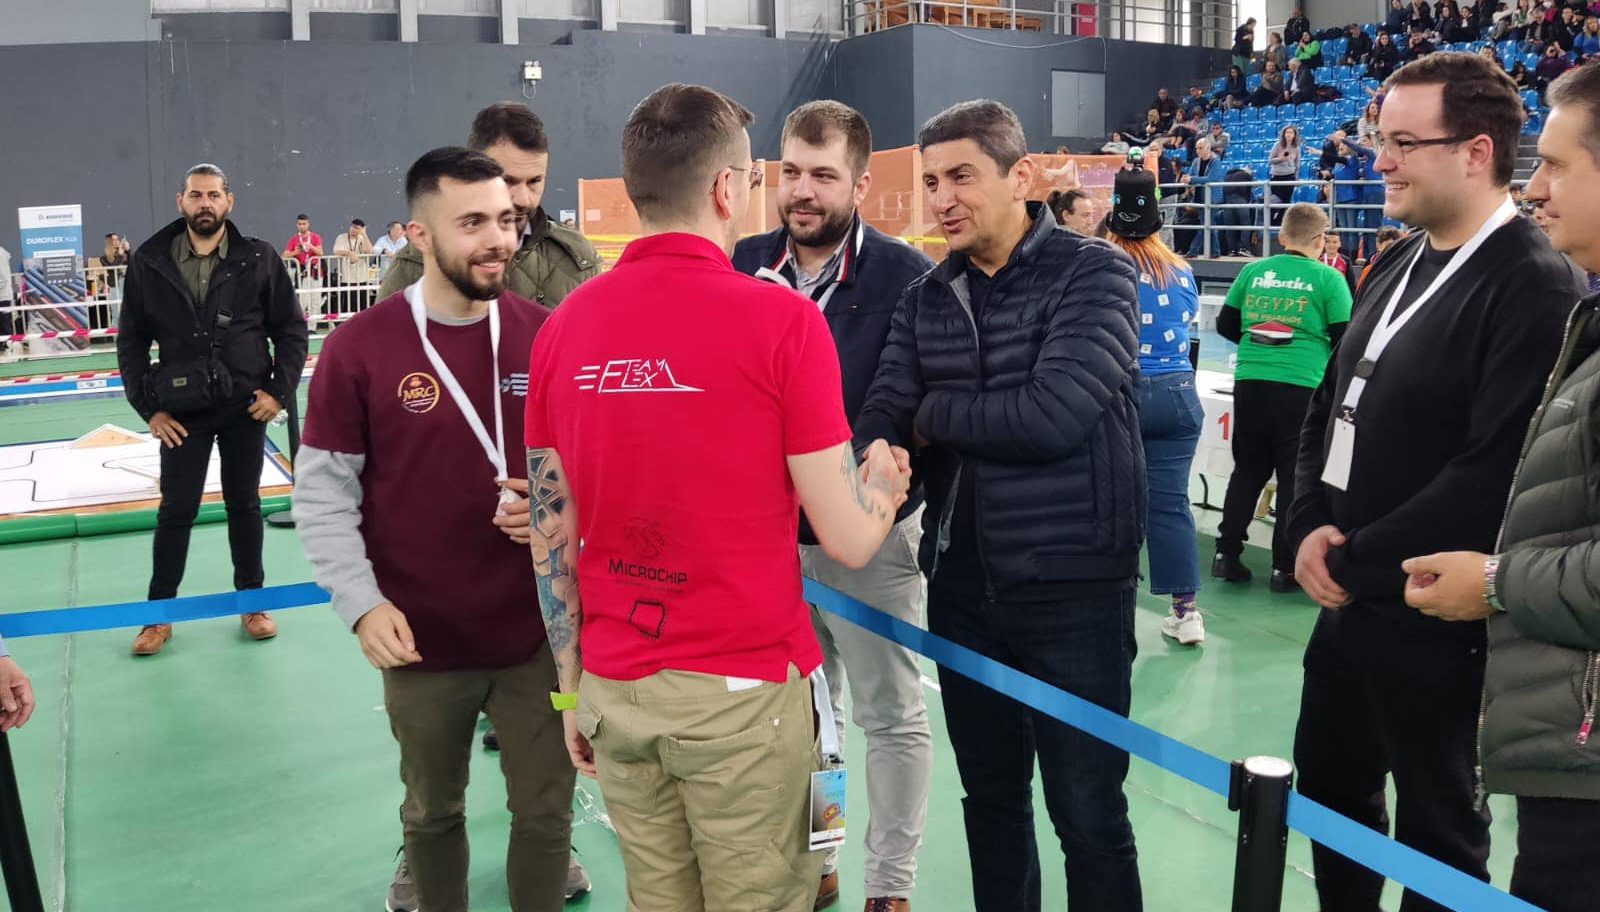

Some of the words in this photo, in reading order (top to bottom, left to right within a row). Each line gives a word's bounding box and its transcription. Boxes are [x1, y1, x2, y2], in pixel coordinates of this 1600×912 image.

[26, 236, 64, 245] DUROFLEX
[1246, 294, 1309, 314] EGYPT
[1217, 411, 1230, 441] 1
